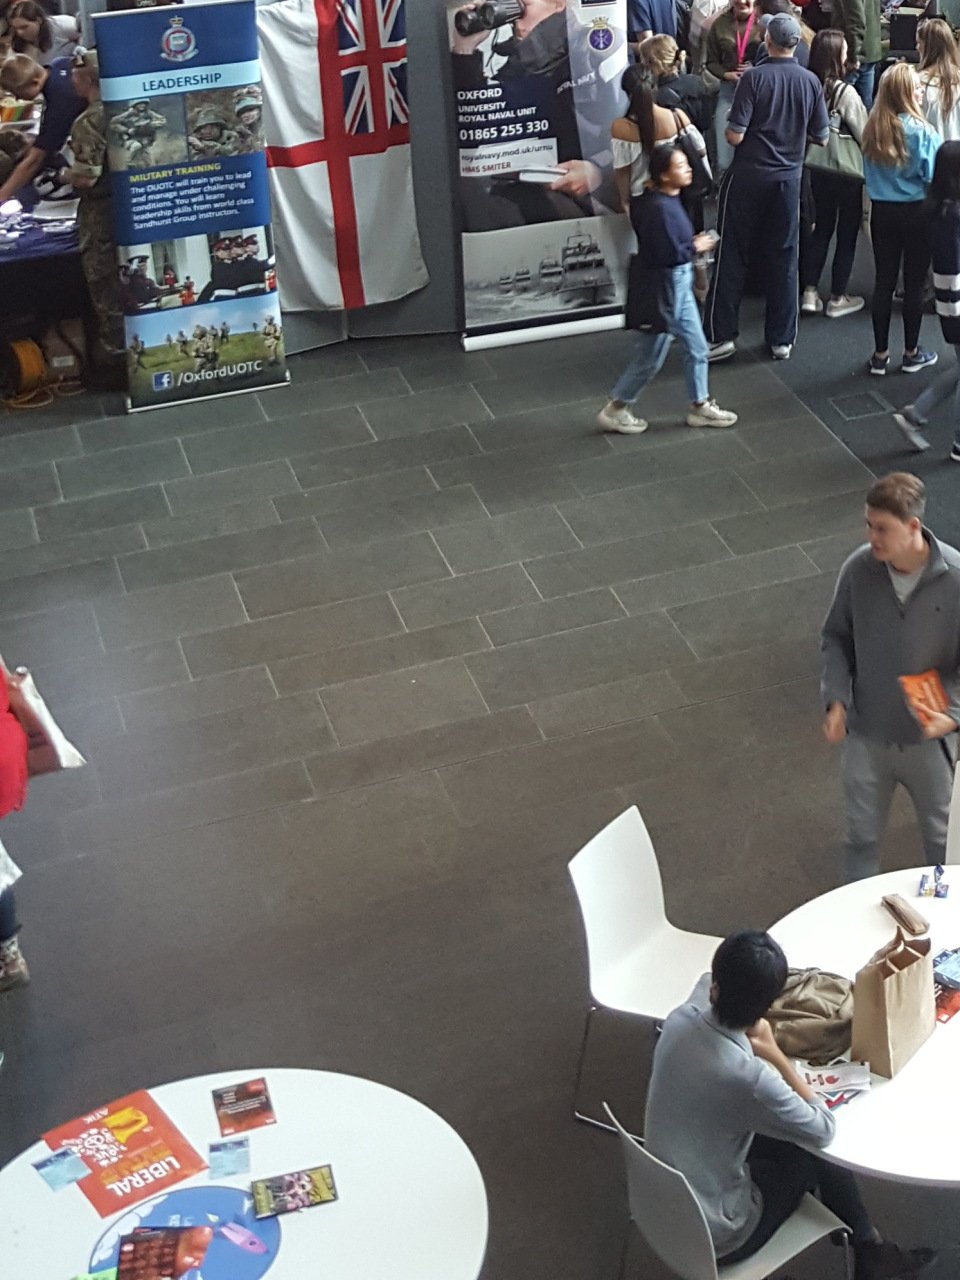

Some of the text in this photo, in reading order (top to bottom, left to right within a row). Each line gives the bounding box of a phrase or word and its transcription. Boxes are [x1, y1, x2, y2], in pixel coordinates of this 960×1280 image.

[142, 72, 222, 91] LEADERSHIP
[457, 88, 502, 100] OXFORD
[458, 101, 506, 112] UNIVERSITY
[459, 107, 536, 122] ROYAL NAVAL UNIT
[460, 120, 549, 140] 01865 255 330
[130, 163, 221, 182] MILITARY TRAINING
[235, 171, 251, 179] lead
[462, 162, 511, 172] HMS SMITER
[132, 182, 245, 203] and manage under challenging
[133, 201, 173, 212] conditions.
[133, 209, 172, 221] leadership
[193, 203, 211, 211] from
[214, 200, 234, 208] world
[134, 208, 240, 230] Sandhurst Group instructors.
